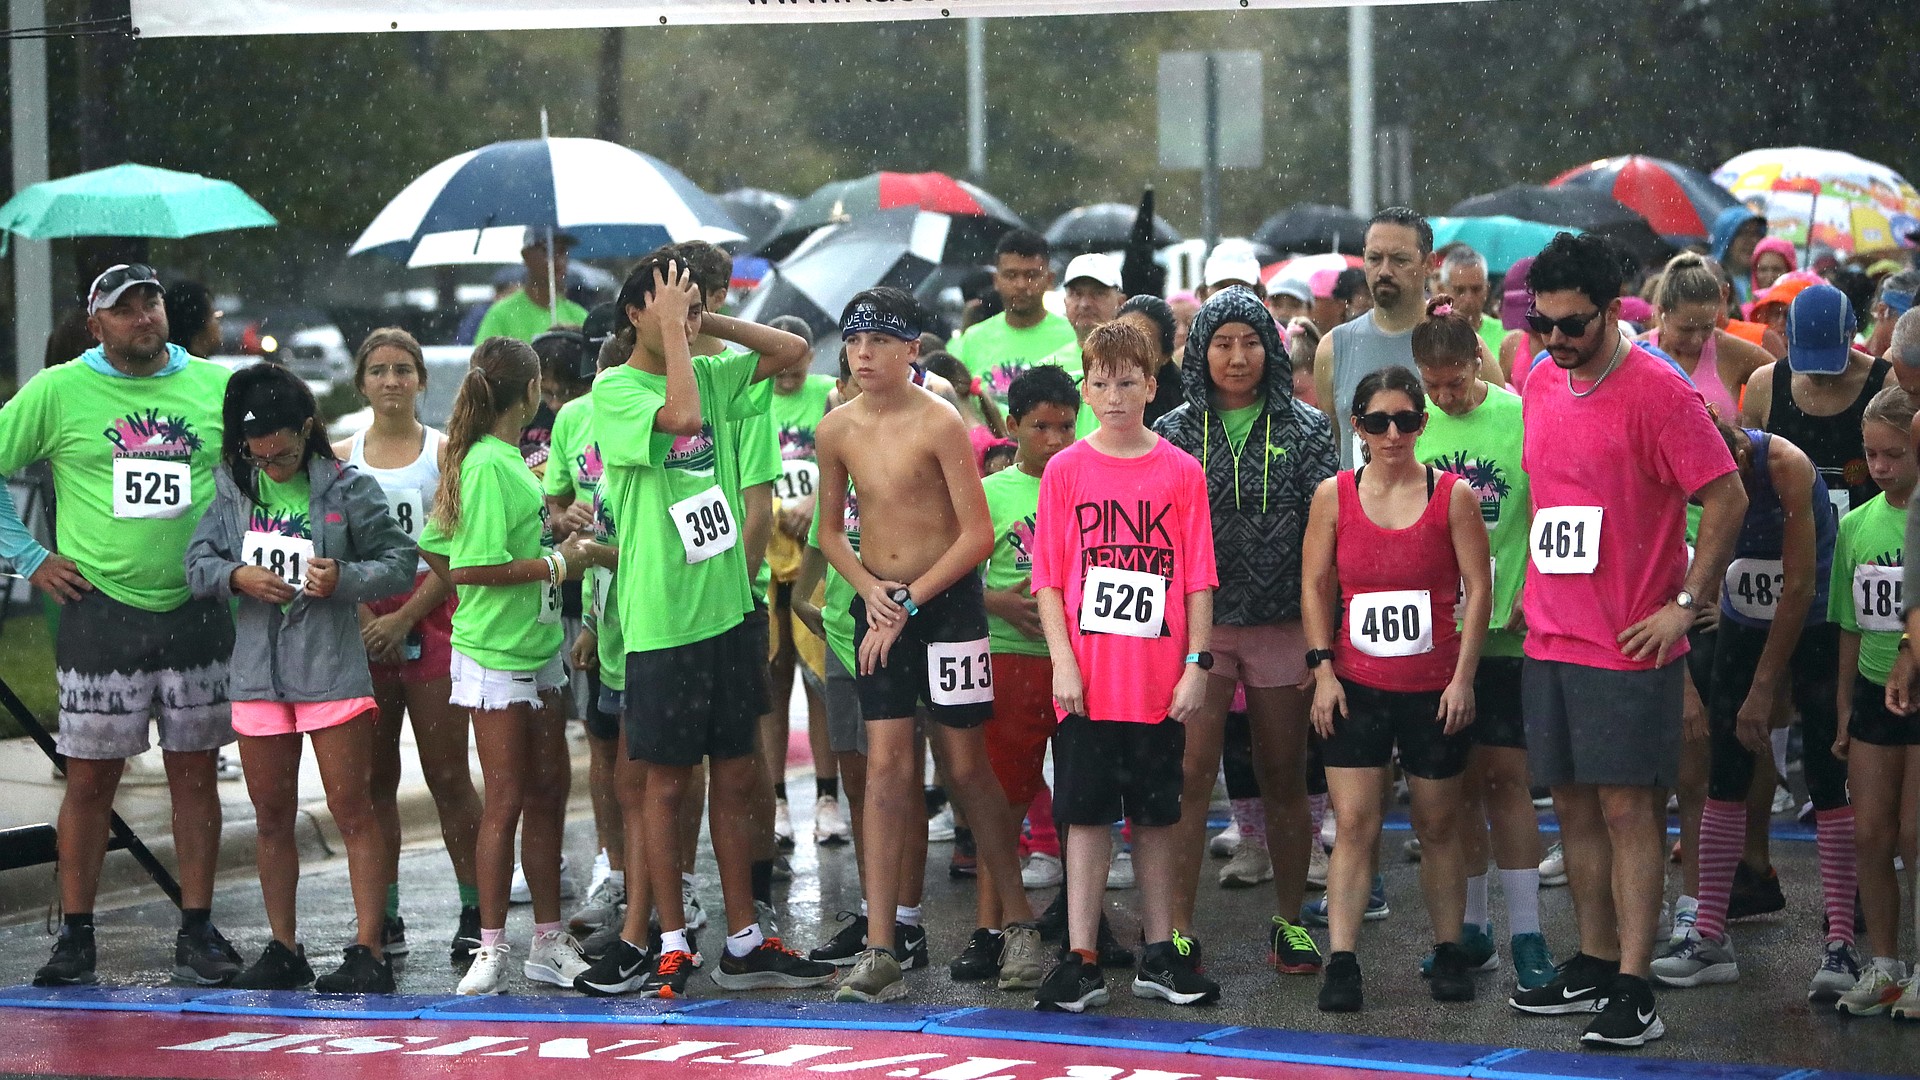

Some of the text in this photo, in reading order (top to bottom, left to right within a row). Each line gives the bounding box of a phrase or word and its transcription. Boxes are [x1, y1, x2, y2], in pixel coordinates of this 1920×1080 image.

[133, 450, 170, 458] PARADE
[125, 471, 181, 506] 525
[685, 500, 730, 547] 399
[1075, 500, 1173, 548] PINK
[1538, 520, 1586, 559] 461
[252, 546, 302, 585] 181
[1083, 547, 1158, 576] ARMY
[1094, 581, 1154, 624] 526
[1361, 604, 1421, 643] 460
[939, 652, 992, 692] 513
